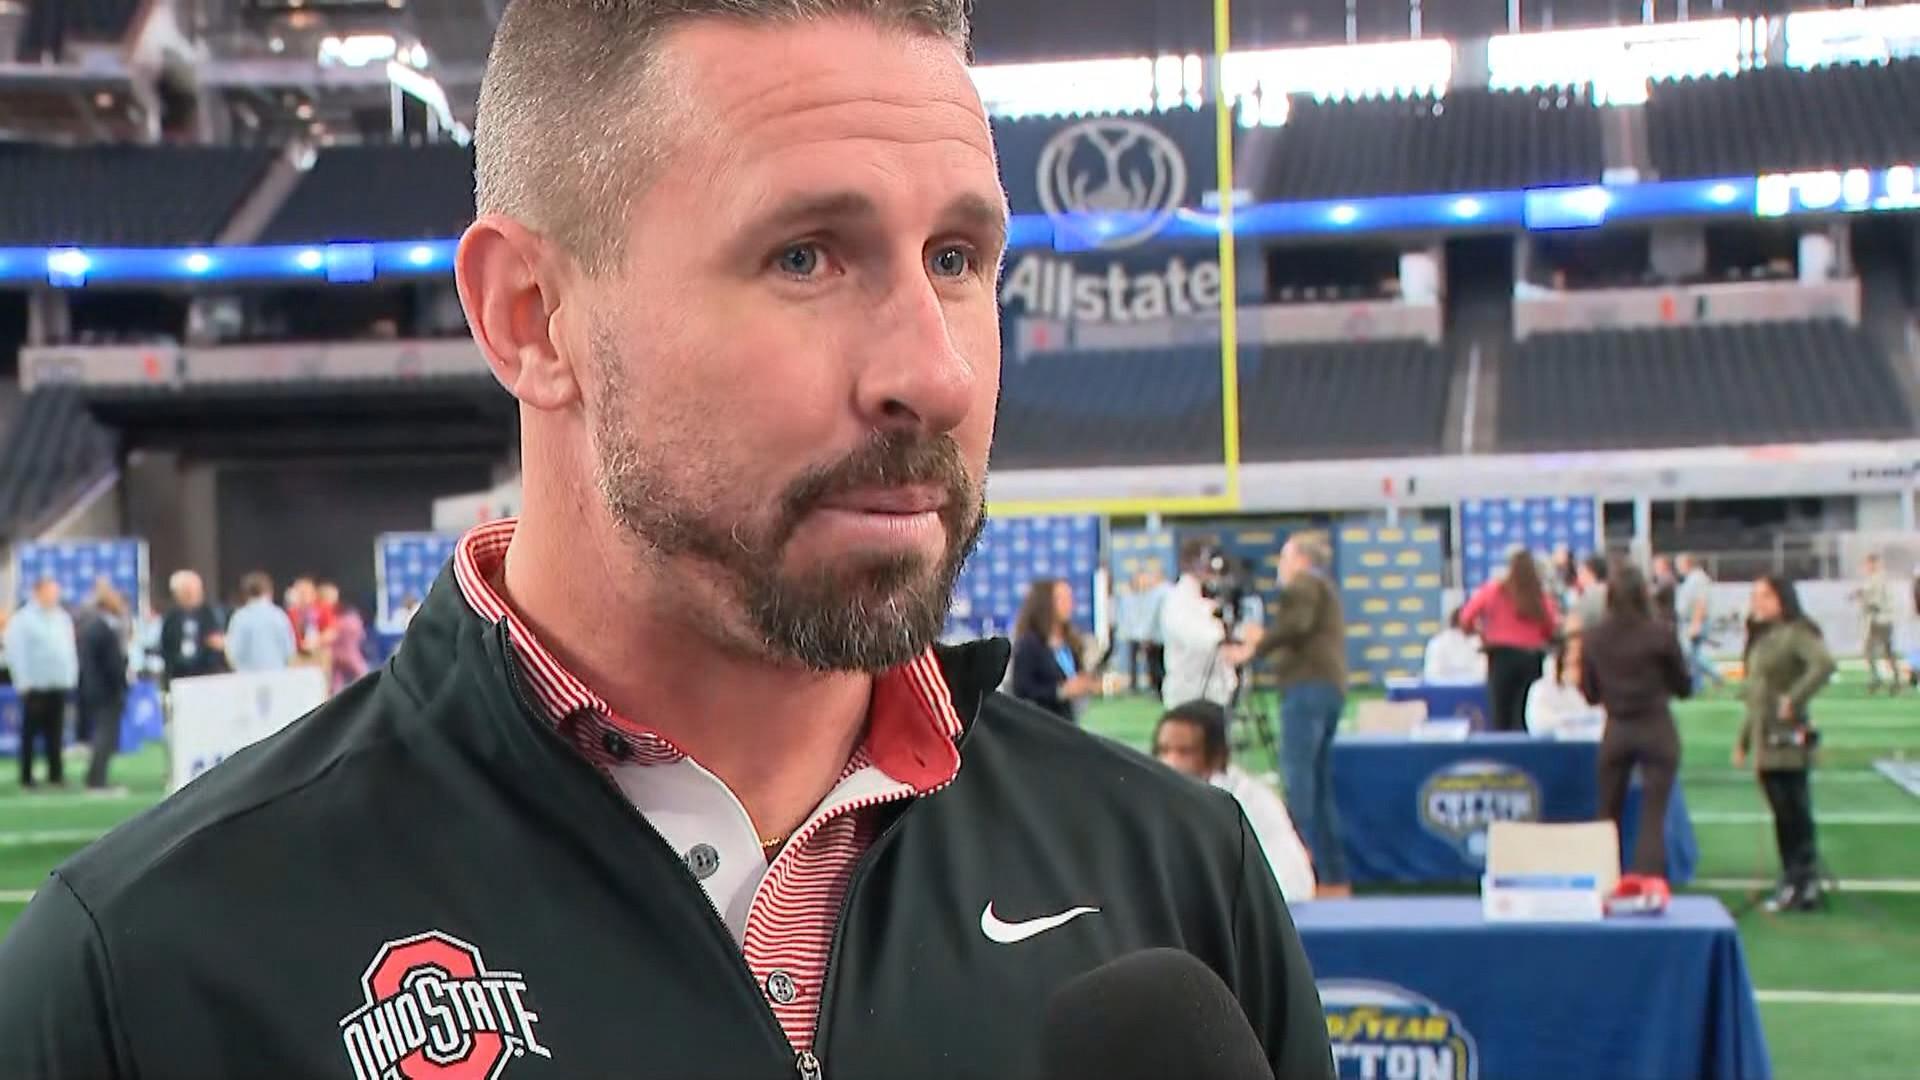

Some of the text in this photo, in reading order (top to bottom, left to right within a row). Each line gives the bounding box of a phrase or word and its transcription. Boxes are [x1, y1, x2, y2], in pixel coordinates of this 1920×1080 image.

[1002, 256, 1220, 320] Allstate
[342, 975, 552, 1080] OHIO STATE
